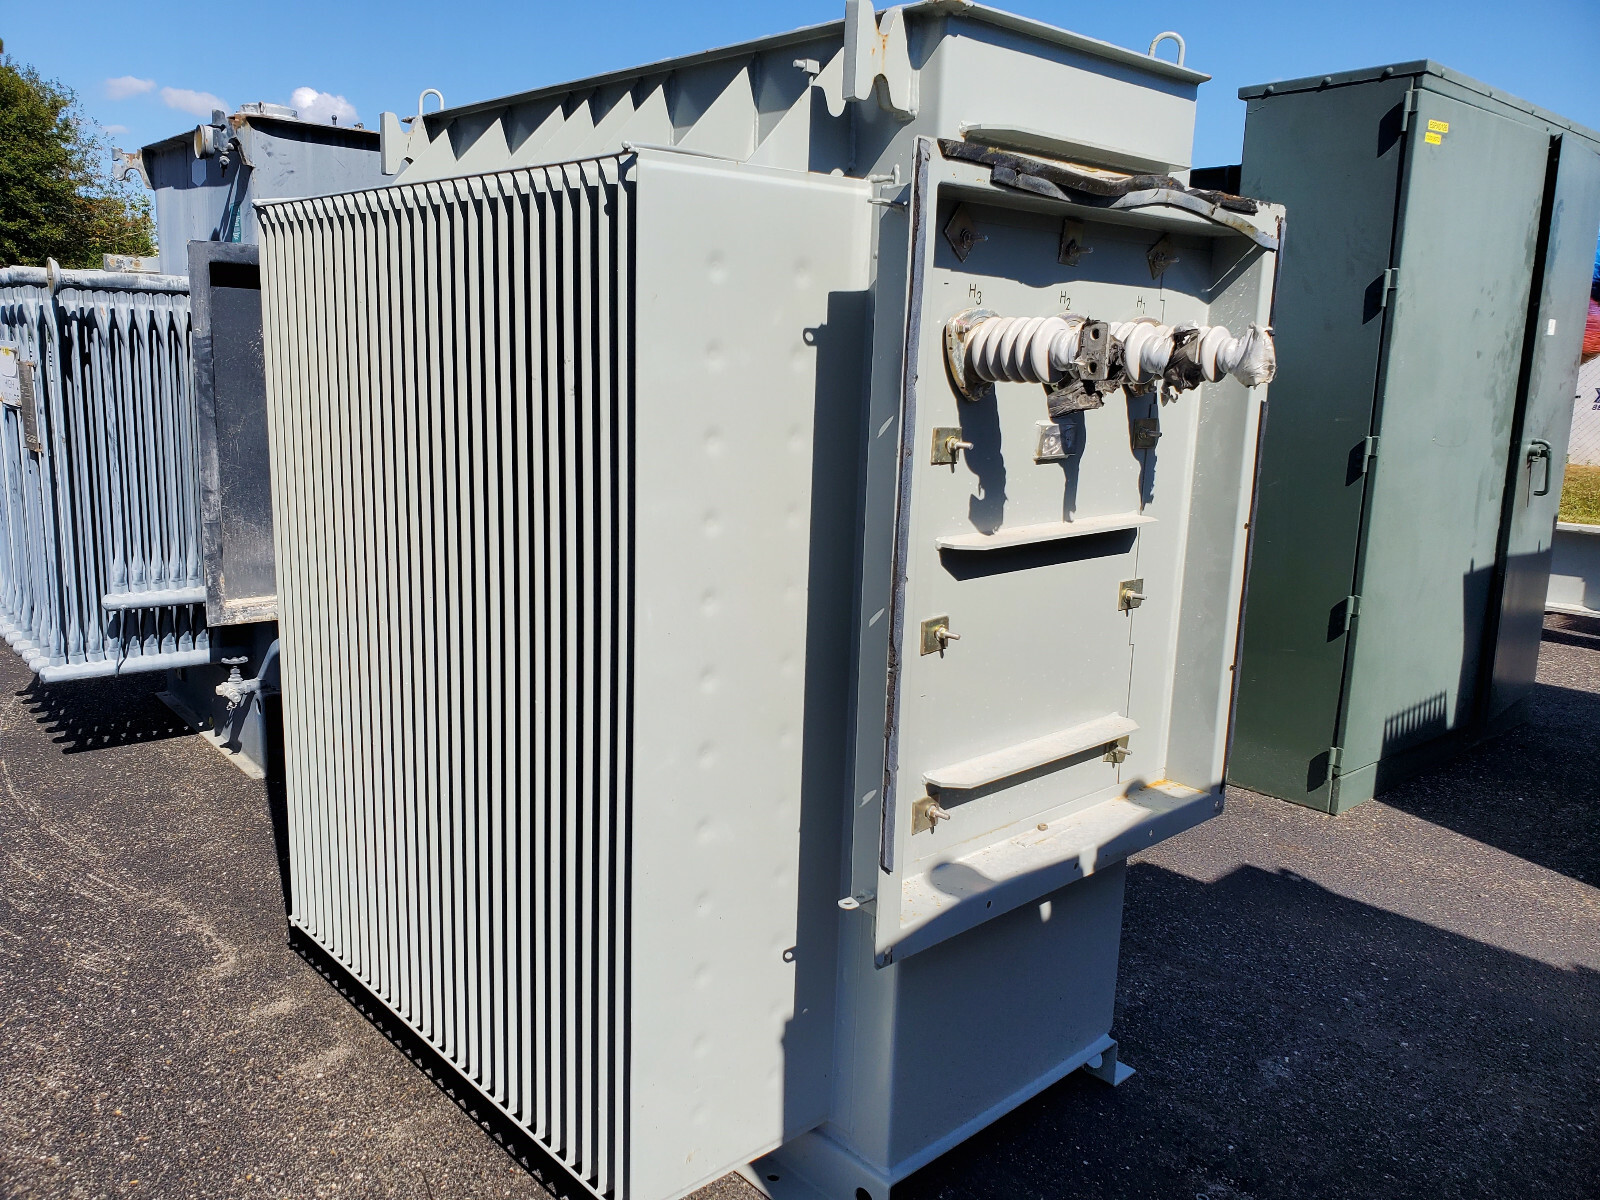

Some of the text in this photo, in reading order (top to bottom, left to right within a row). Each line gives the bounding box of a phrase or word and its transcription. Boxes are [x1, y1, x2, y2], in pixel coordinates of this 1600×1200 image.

[968, 283, 982, 305] H3
[1059, 290, 1071, 310] H2
[1136, 295, 1146, 314] H1
